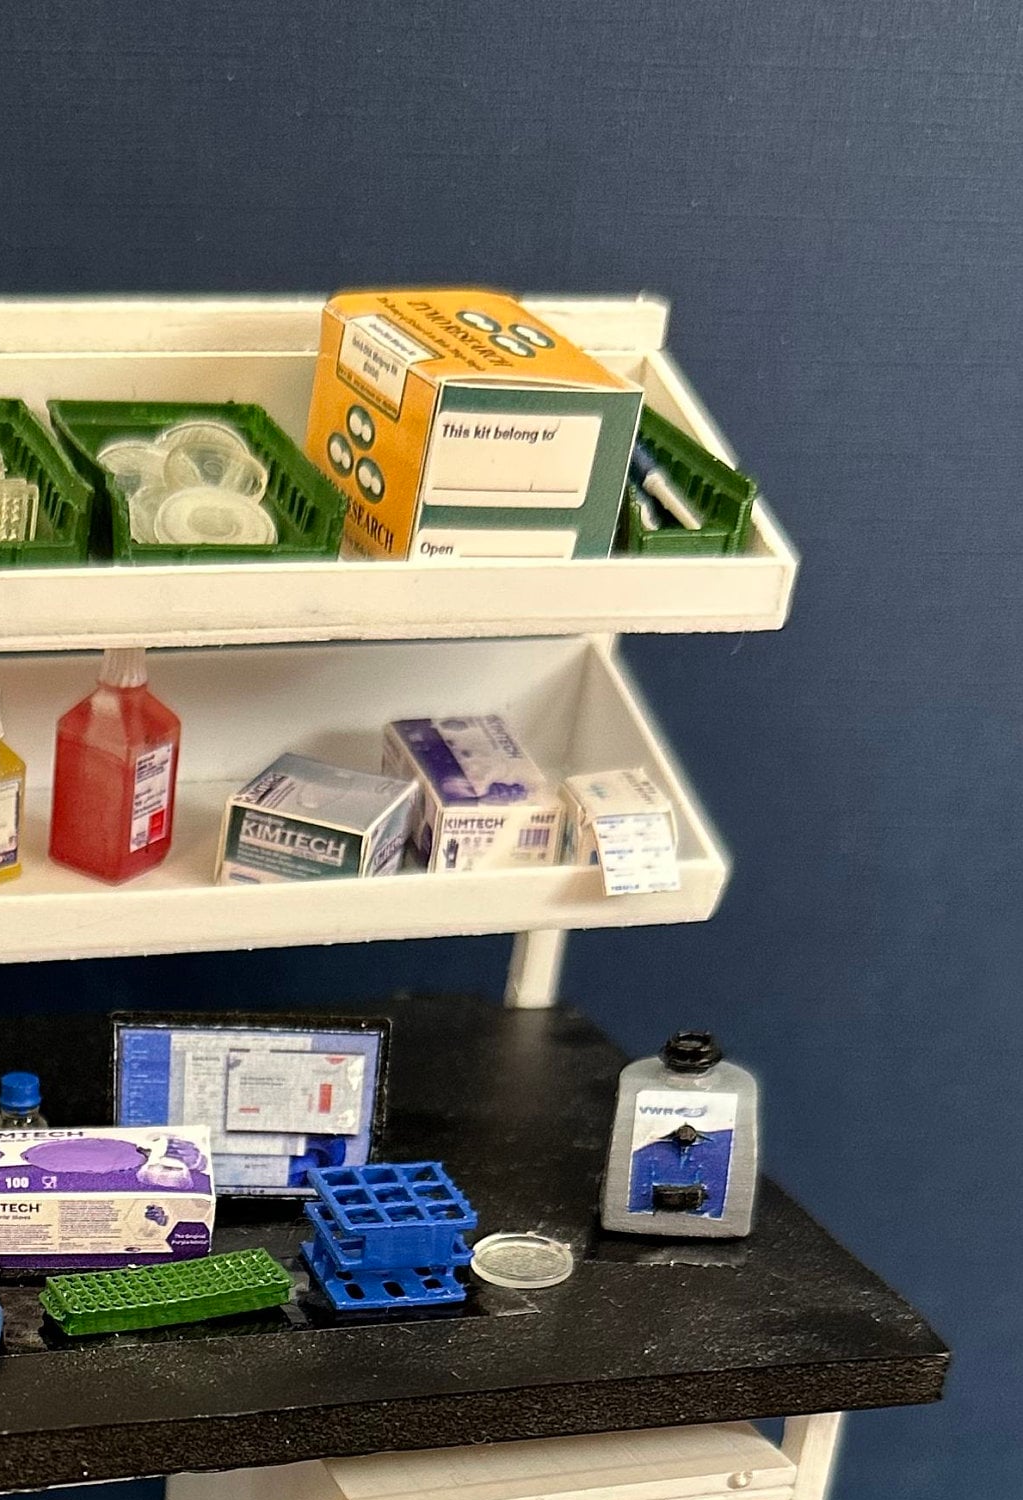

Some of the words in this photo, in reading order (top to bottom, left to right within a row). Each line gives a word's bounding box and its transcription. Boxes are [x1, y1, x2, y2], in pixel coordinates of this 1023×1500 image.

[441, 424, 470, 439] This
[474, 424, 491, 439] kit
[493, 425, 538, 444] belong
[542, 427, 555, 440] to
[420, 542, 455, 557] Open
[443, 817, 505, 829] KIMTECH
[241, 820, 347, 860] KIMTECH
[639, 1105, 674, 1116] VWR
[5, 1177, 30, 1189] 100
